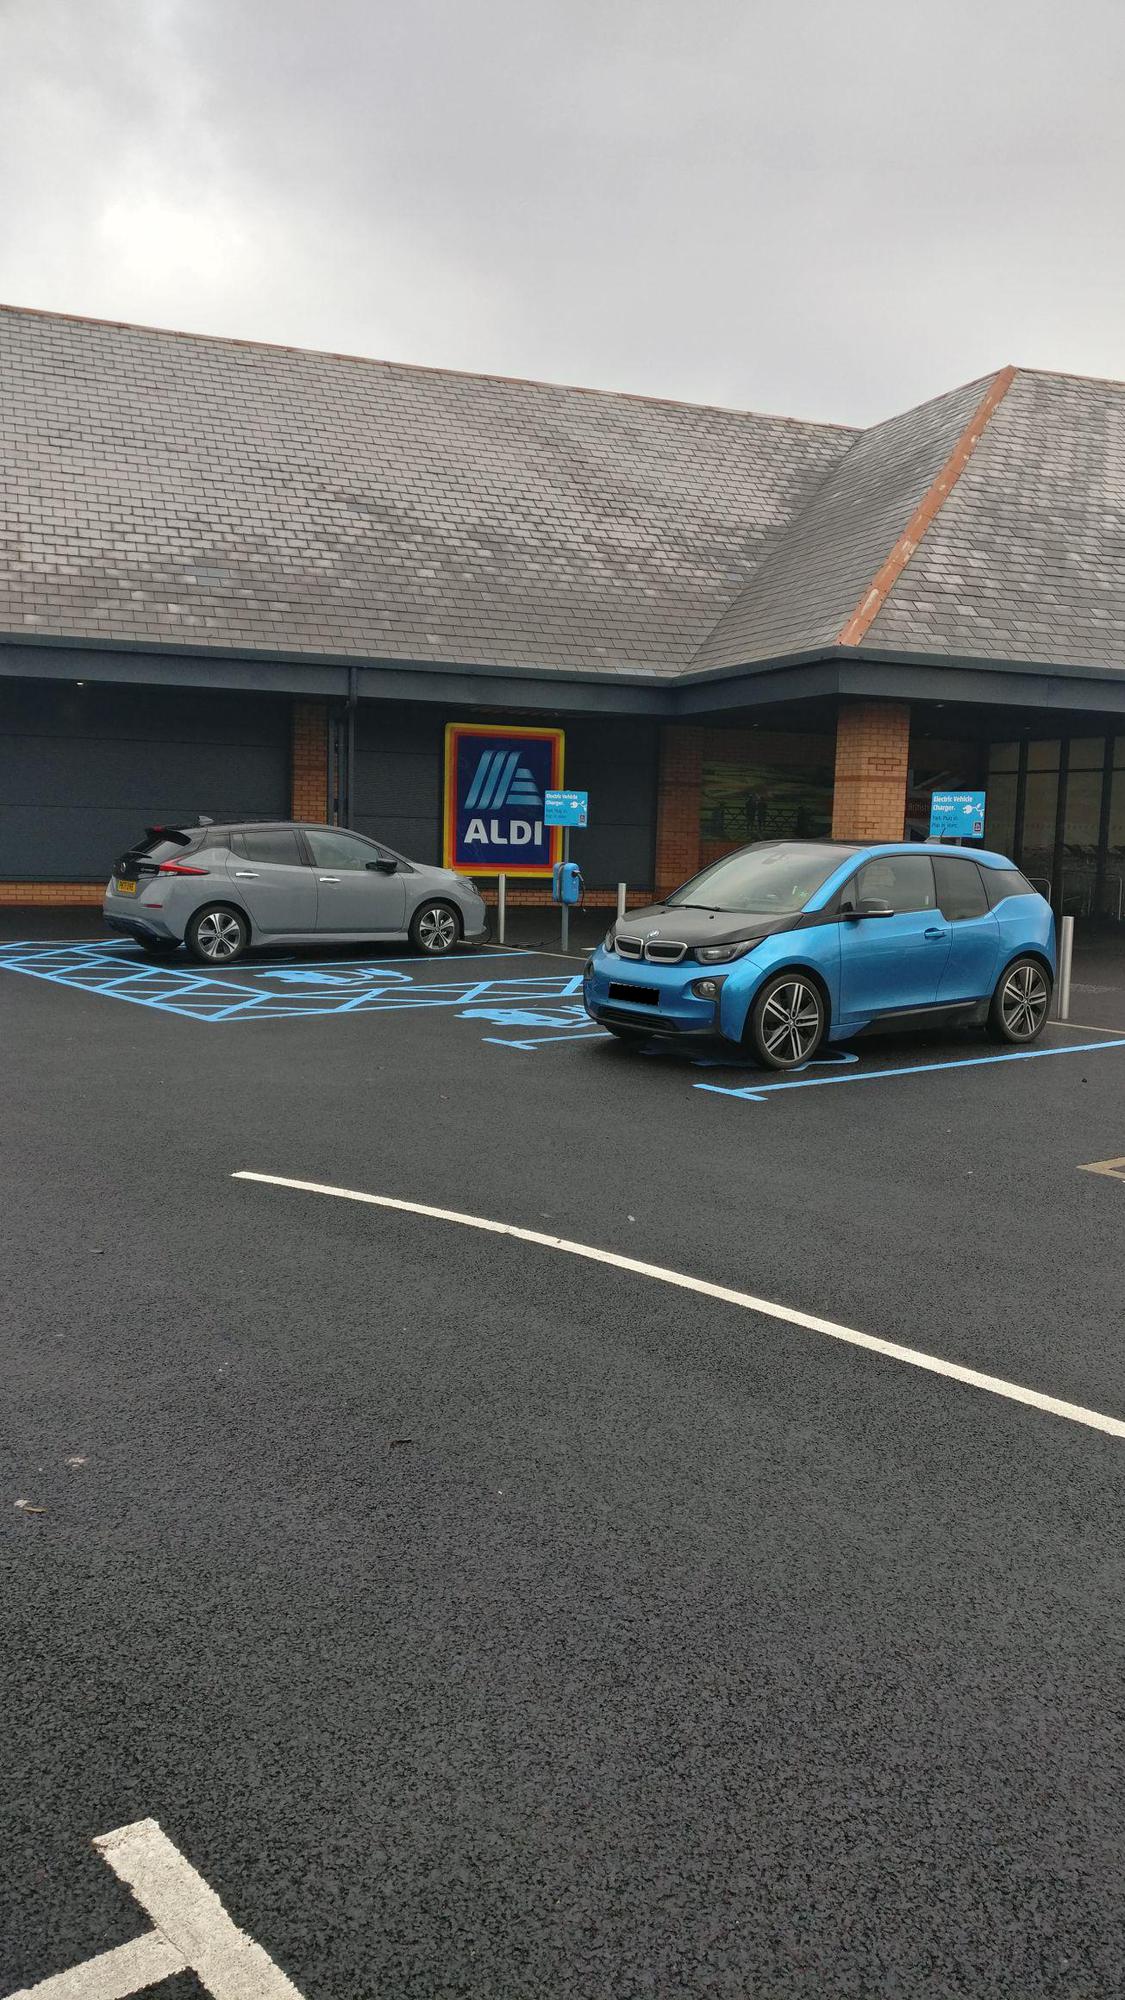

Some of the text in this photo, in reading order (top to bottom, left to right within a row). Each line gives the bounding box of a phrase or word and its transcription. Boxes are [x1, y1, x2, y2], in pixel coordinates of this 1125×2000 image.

[933, 795, 973, 803] Electric Vehicle
[933, 804, 956, 812] Charger.
[464, 818, 542, 846] ALDI
